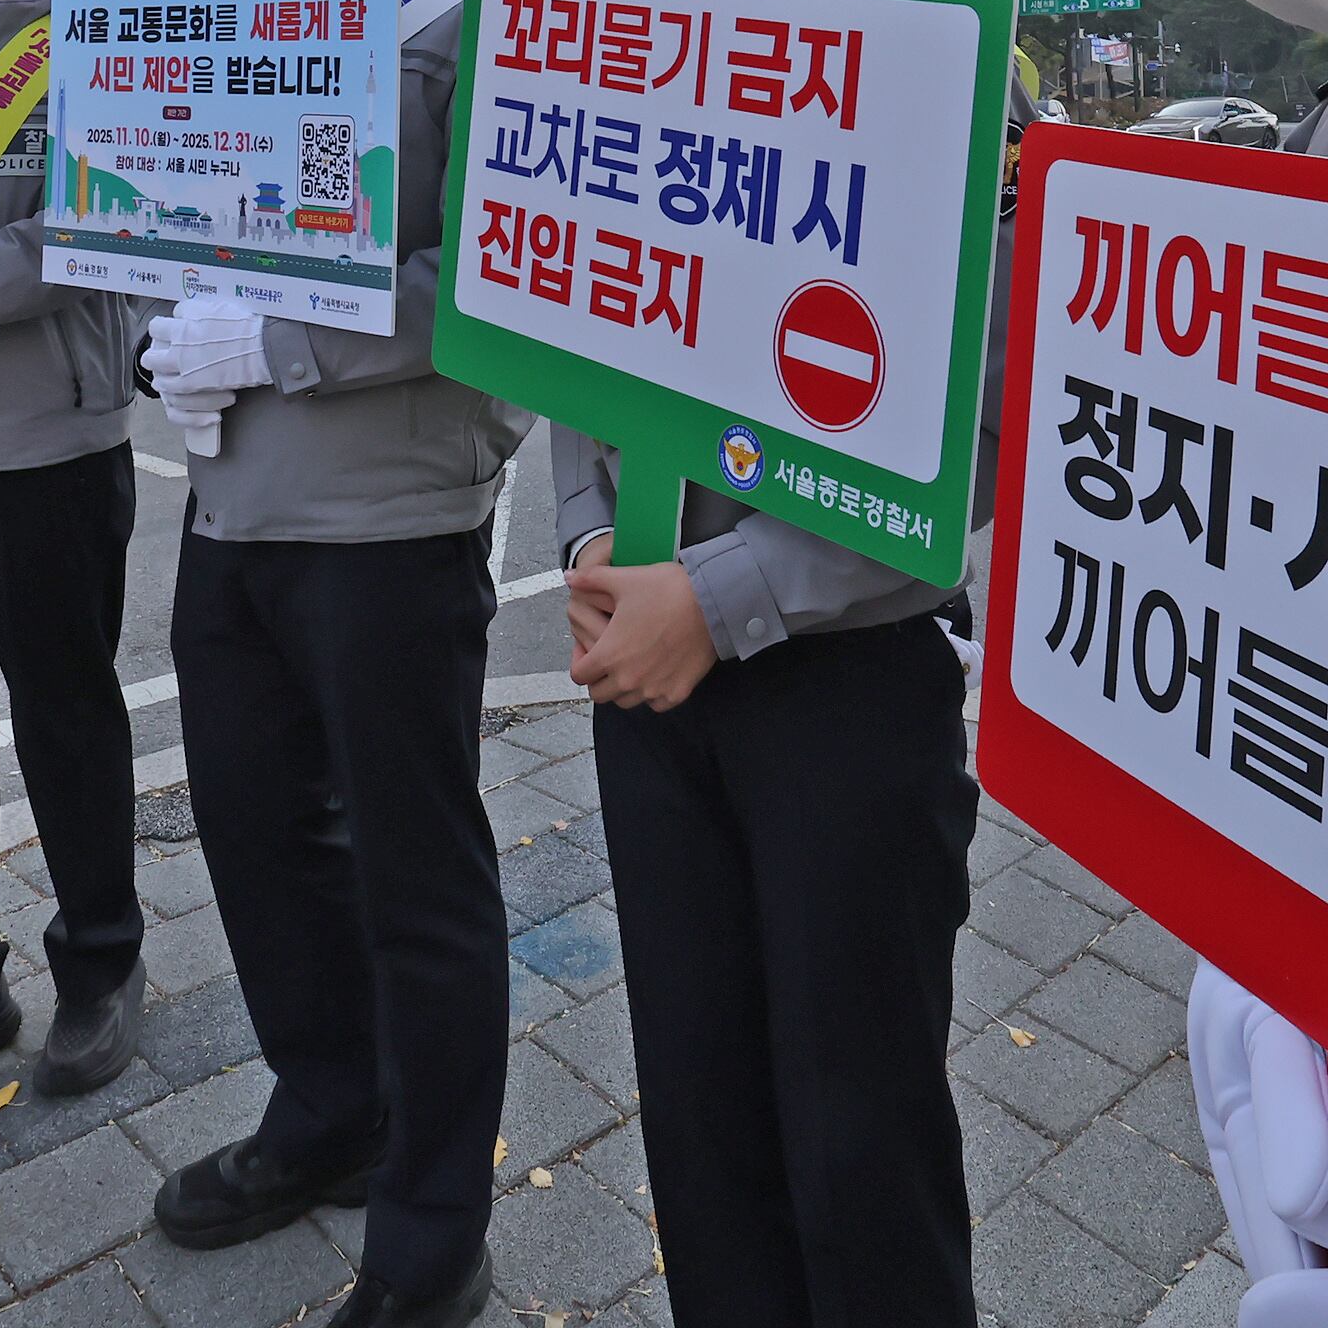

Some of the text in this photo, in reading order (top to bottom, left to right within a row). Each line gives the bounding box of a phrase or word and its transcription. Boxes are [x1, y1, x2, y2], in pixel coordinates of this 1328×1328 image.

[65, 7, 110, 44] 서울
[117, 4, 238, 44] 교통문화를
[250, 0, 330, 41] 새롭게
[89, 56, 341, 96] 시민 제안을 받습니다!
[727, 16, 864, 131] 금지
[24, 130, 46, 153] 찰
[116, 155, 134, 171] 참여
[166, 158, 185, 174] 서울
[188, 159, 207, 175] 시민
[210, 160, 240, 177] 누구나
[485, 97, 867, 267] 교차로 정체 시
[78, 263, 109, 274] 서울경찰청
[136, 271, 162, 284] 서울특별시
[478, 199, 704, 348] 진입 금지
[774, 458, 933, 549] 서울종로경찰서
